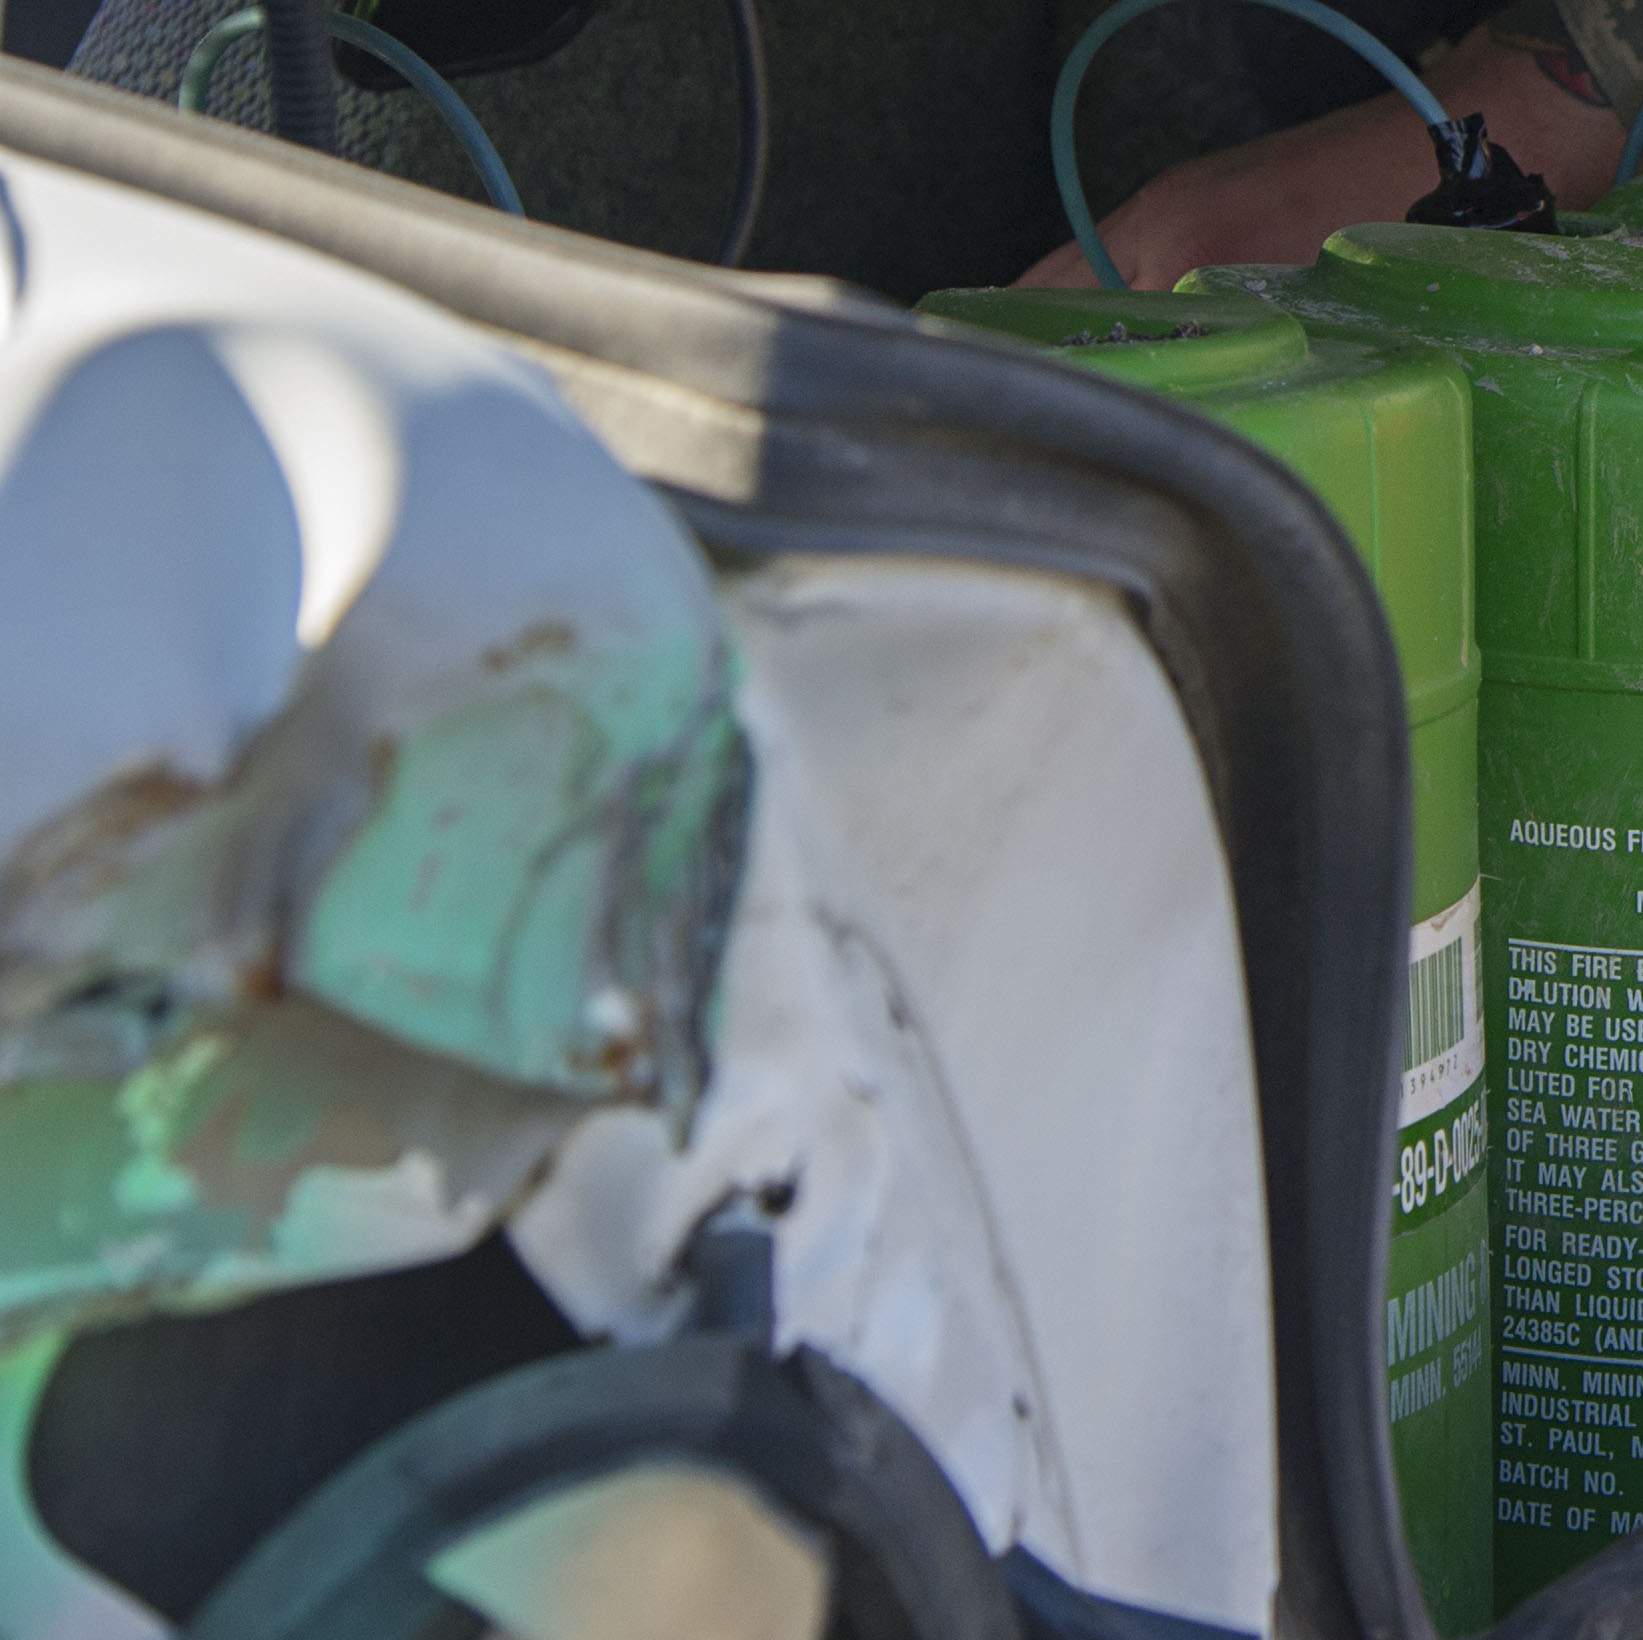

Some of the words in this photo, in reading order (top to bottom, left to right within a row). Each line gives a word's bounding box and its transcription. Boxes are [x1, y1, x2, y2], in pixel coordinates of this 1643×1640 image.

[1509, 819, 1617, 853] AQUEOUS
[1508, 946, 1558, 976] THIS
[1572, 952, 1622, 981] FIRE
[1508, 976, 1612, 1011] DILUTION
[1508, 1005, 1556, 1036] MAY
[1566, 1012, 1594, 1039] BE
[1508, 1035, 1553, 1065] DRY
[1508, 1066, 1576, 1098] LUTED
[1588, 1074, 1634, 1103] FOR
[1507, 1096, 1547, 1126] SEA
[1560, 1102, 1641, 1135] WATER
[1506, 1156, 1525, 1183] IT
[1538, 1160, 1588, 1190] MAY
[1505, 1223, 1547, 1252] FOR
[1387, 1251, 1476, 1368] MINING
[1503, 1314, 1580, 1347] 24385C
[1503, 1360, 1566, 1391] MINN.
[1502, 1390, 1637, 1428] INDUSTRIAL
[1500, 1420, 1532, 1447] ST.
[1549, 1427, 1614, 1460] PAUL,
[1500, 1459, 1569, 1491] BATCH
[1584, 1469, 1624, 1496] NO.
[1499, 1497, 1552, 1527] DATE
[1567, 1506, 1596, 1531] OF
